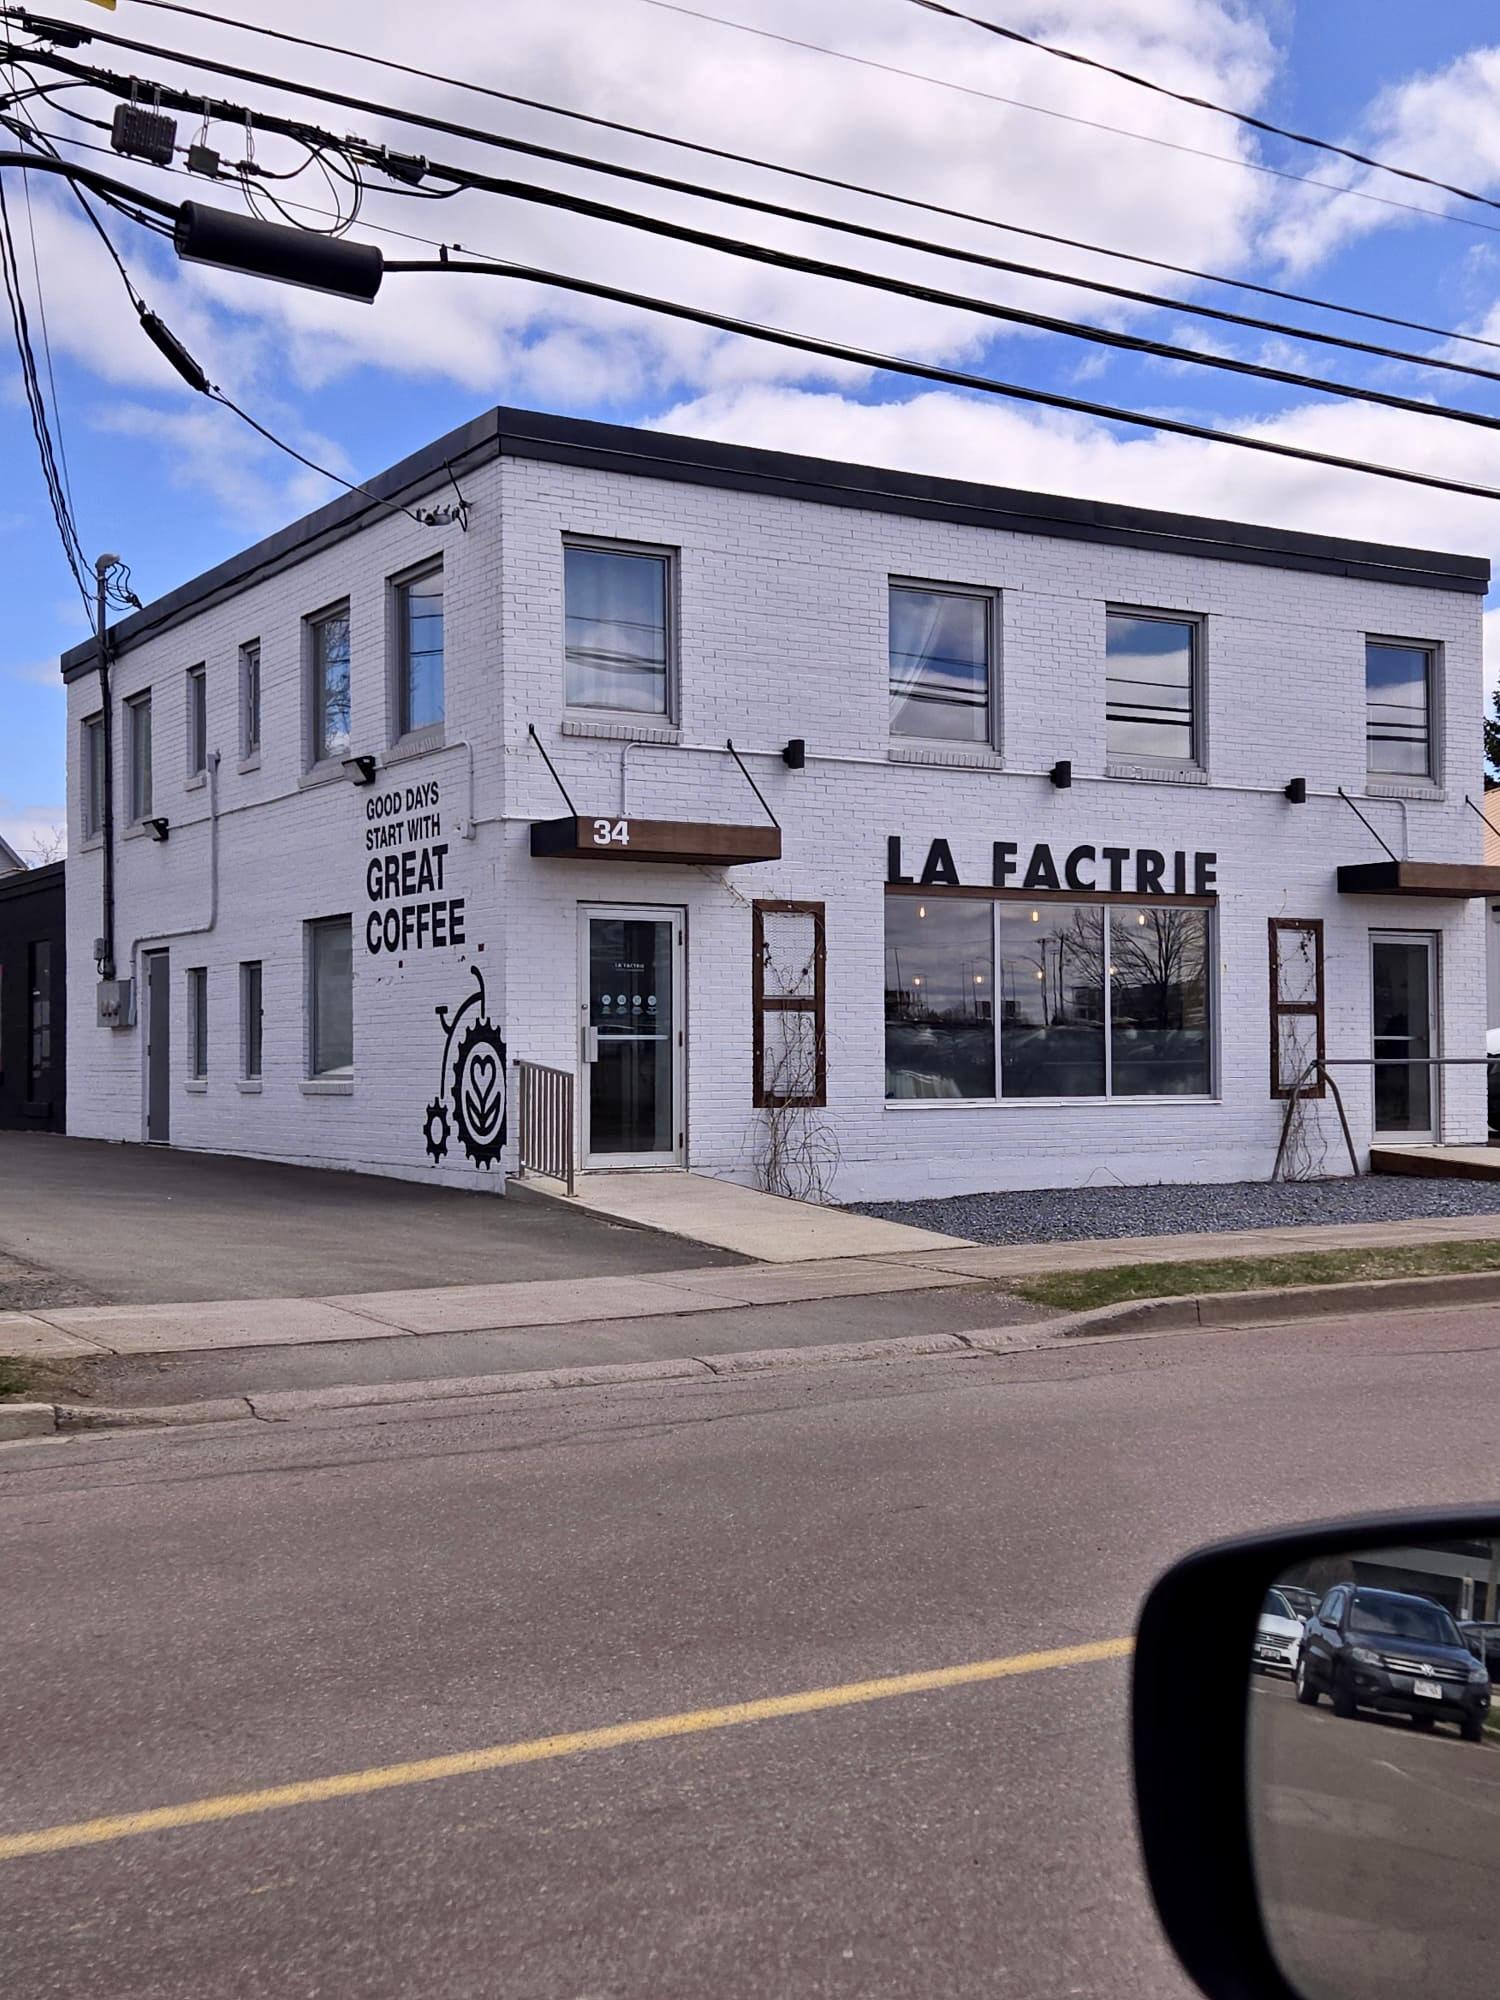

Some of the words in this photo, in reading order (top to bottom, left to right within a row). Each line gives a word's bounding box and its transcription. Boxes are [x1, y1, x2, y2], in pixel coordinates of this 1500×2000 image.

[366, 791, 402, 820] GOOD
[405, 781, 440, 812] DAYS
[366, 821, 404, 850] START
[406, 813, 440, 841] WITH
[593, 819, 630, 845] 34
[366, 844, 448, 902] GREAT
[887, 835, 960, 885] LA
[992, 841, 1217, 895] FACTRIE
[366, 898, 465, 954] COFFEE
